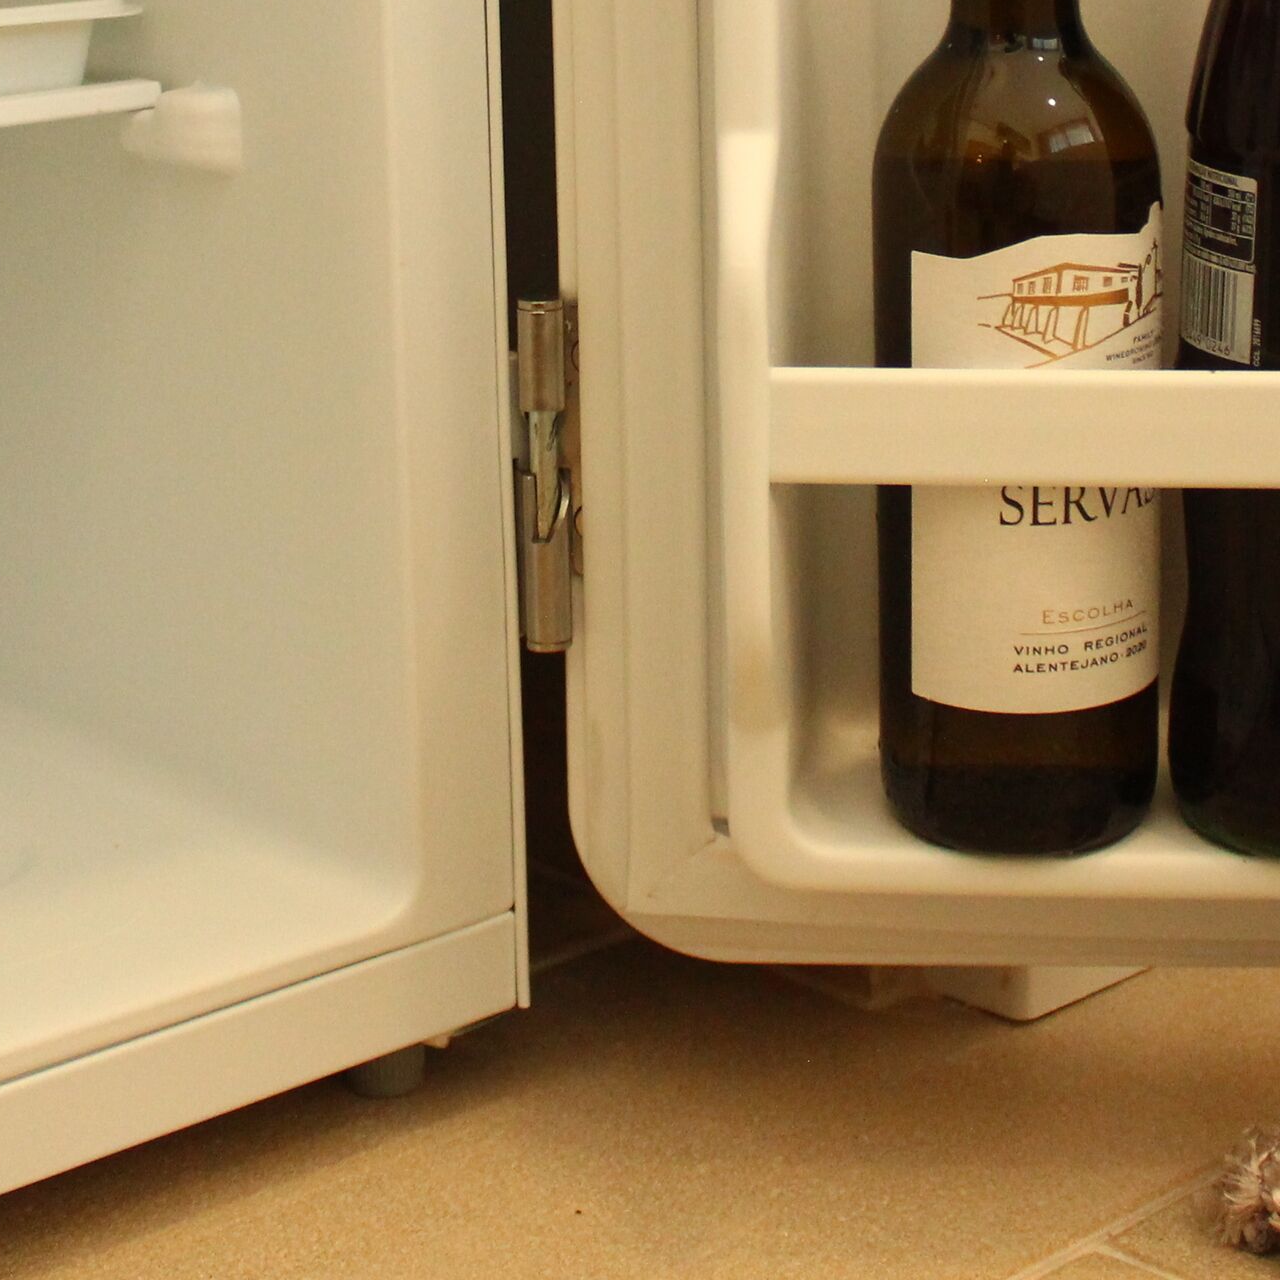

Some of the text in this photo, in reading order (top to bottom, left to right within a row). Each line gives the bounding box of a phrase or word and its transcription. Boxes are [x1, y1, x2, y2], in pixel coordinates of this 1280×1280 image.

[1042, 599, 1134, 625] ESCOLHA
[1013, 622, 1149, 656] VINHO REGIONAL
[1013, 652, 1119, 673] ALENTEJANO
